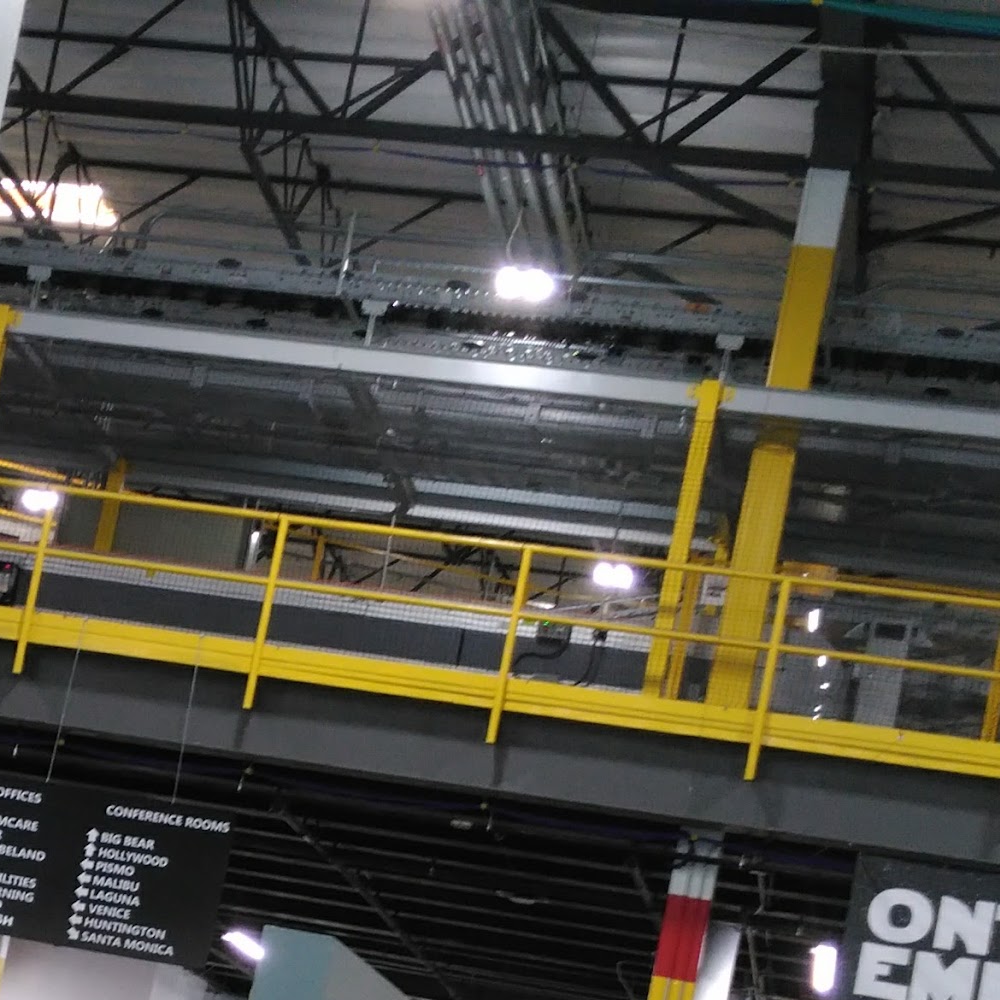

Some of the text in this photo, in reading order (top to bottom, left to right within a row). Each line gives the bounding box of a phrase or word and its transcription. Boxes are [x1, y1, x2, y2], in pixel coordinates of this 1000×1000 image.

[105, 804, 230, 833] CONFERENCE ROOMS
[100, 832, 154, 849] BIG BEAR
[98, 847, 167, 867] HOLLYWOOD
[95, 861, 134, 875] PISMO
[92, 875, 139, 891] MALIBU
[89, 888, 139, 906] LAGUNA
[88, 904, 130, 919] VENICE
[83, 917, 165, 939] HUNTINGTON
[868, 887, 1000, 956] ON
[80, 931, 173, 956] SANTA MONICA
